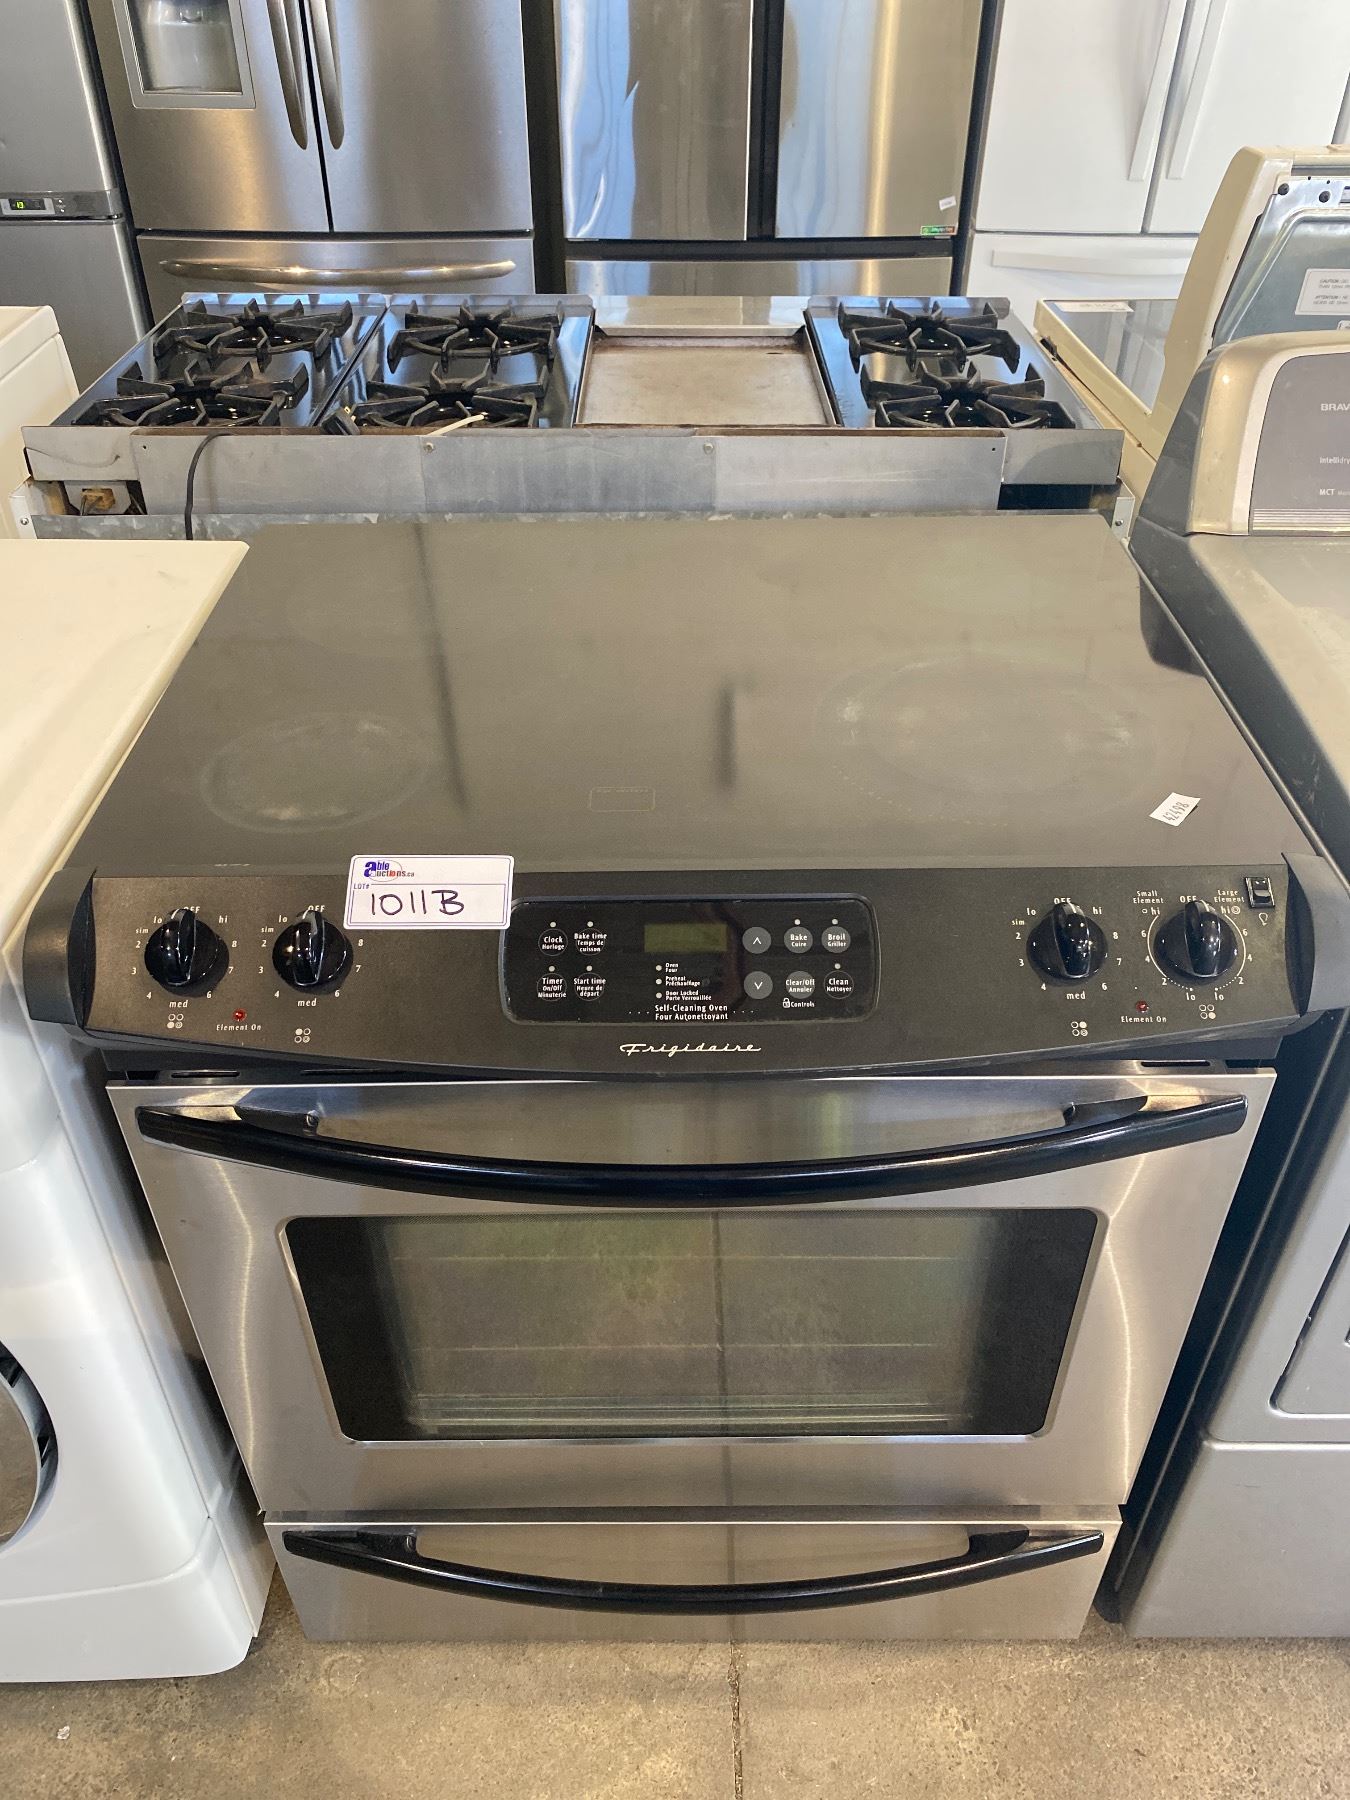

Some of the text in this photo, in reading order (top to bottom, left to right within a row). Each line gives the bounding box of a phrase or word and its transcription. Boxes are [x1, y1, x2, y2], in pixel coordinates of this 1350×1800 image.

[1026, 908, 1036, 916] lo
[1151, 907, 1160, 915] hi
[1066, 991, 1085, 1000] med
[1186, 992, 1196, 1000] lo
[1215, 992, 1224, 1000] lo
[297, 998, 317, 1006] med
[655, 1004, 706, 1012] Self-Cleaning
[675, 1013, 728, 1021] Autonettoyant
[620, 1043, 762, 1057] Frigidaire
